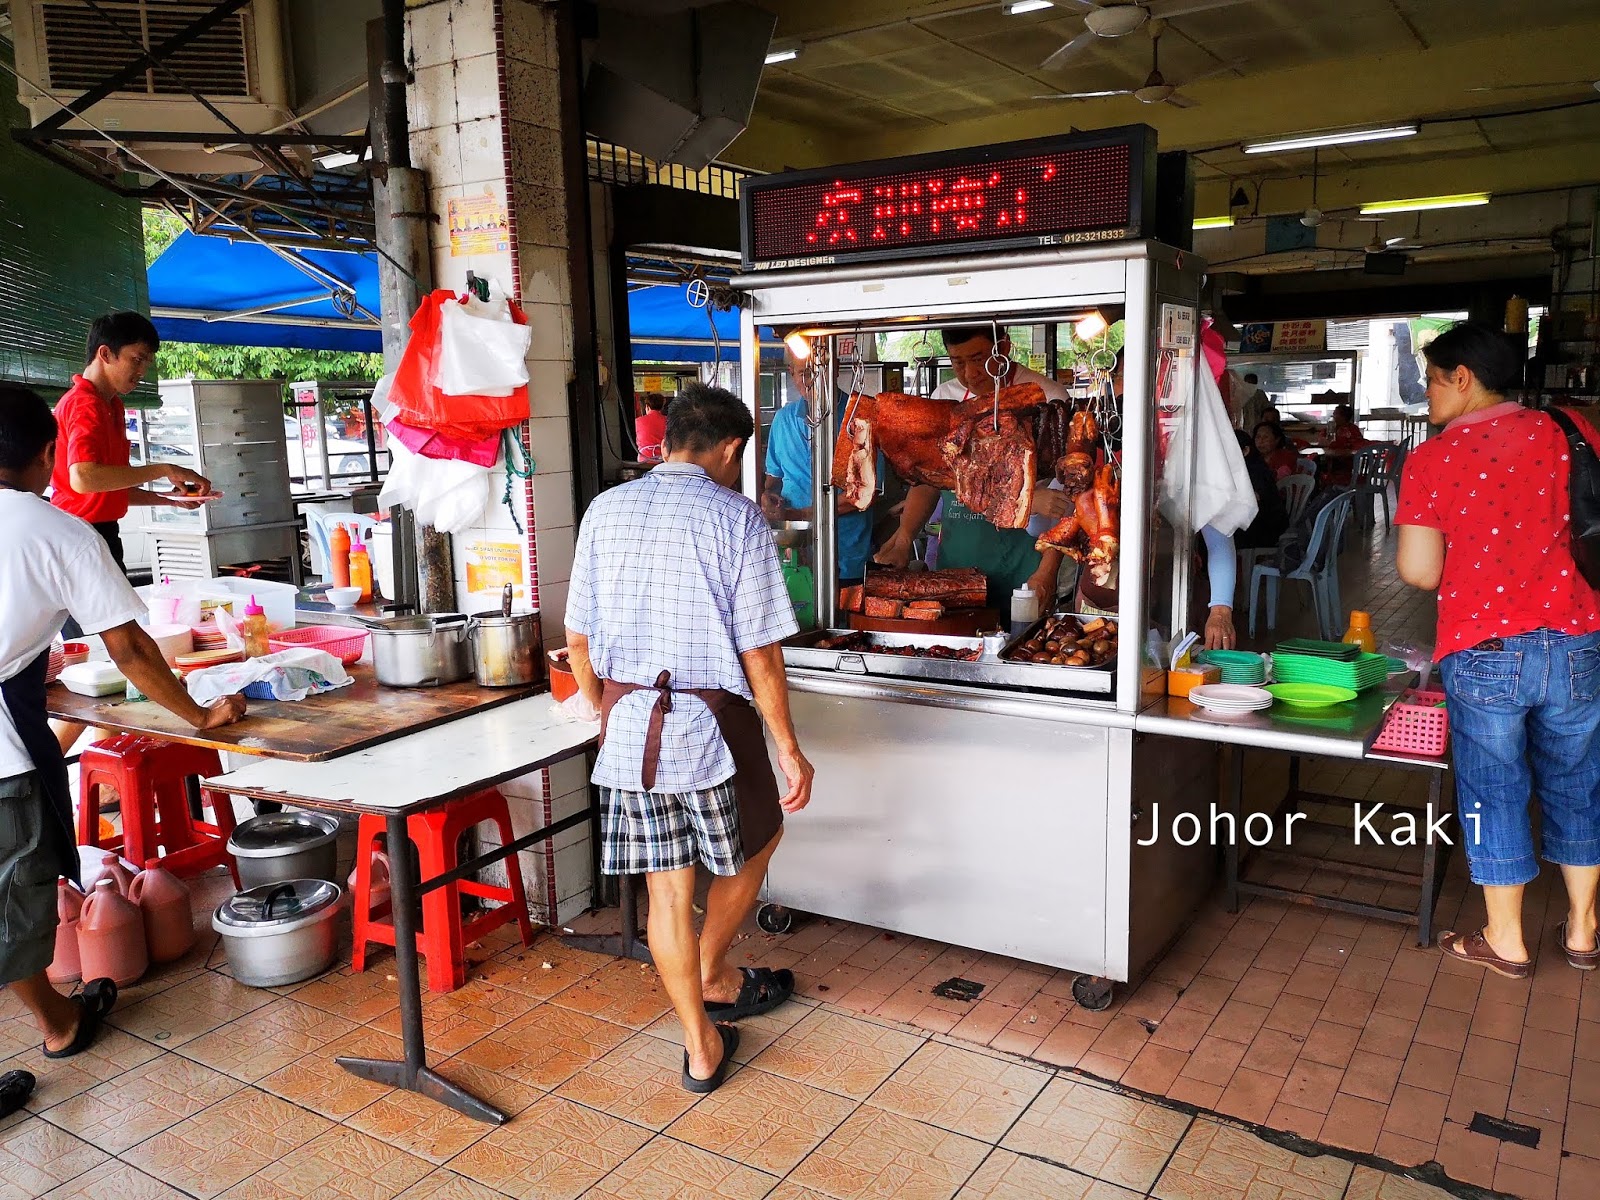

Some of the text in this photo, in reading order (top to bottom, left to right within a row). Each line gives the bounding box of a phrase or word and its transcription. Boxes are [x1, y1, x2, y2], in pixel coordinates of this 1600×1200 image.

[1038, 235, 1057, 246] TEL
[1064, 229, 1125, 243] 012-3218333
[770, 260, 787, 269] LED
[787, 256, 835, 268] DESIGNER
